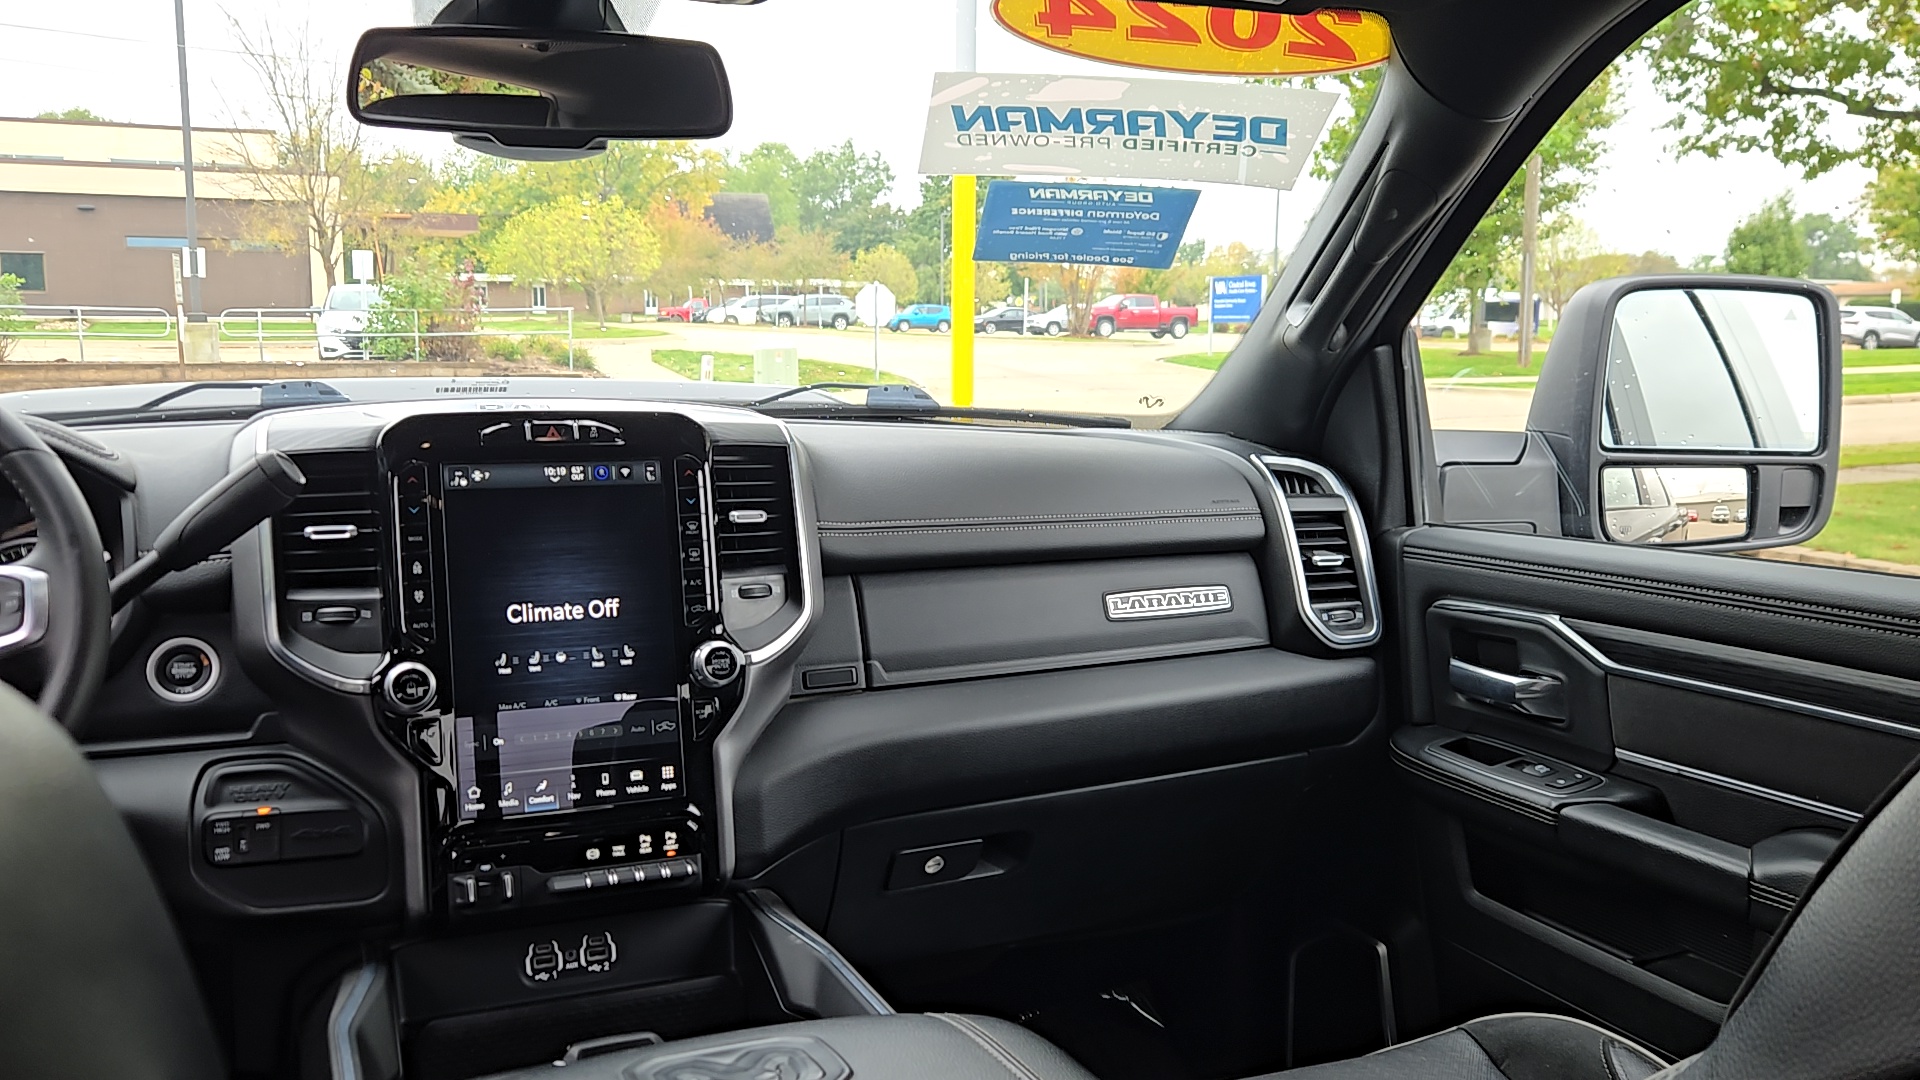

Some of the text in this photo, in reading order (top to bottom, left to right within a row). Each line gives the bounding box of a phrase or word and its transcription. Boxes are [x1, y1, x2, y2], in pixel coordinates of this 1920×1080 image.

[543, 465, 567, 477] 10:19
[570, 473, 584, 481] OUT
[1111, 591, 1228, 612] LARAMIE
[506, 597, 620, 624] Climate Off
[545, 699, 558, 707] A/C
[493, 737, 505, 747] On
[464, 782, 677, 811] Home Media Comfort Nav Phone Vehicle Apps
[603, 961, 610, 971] 2
